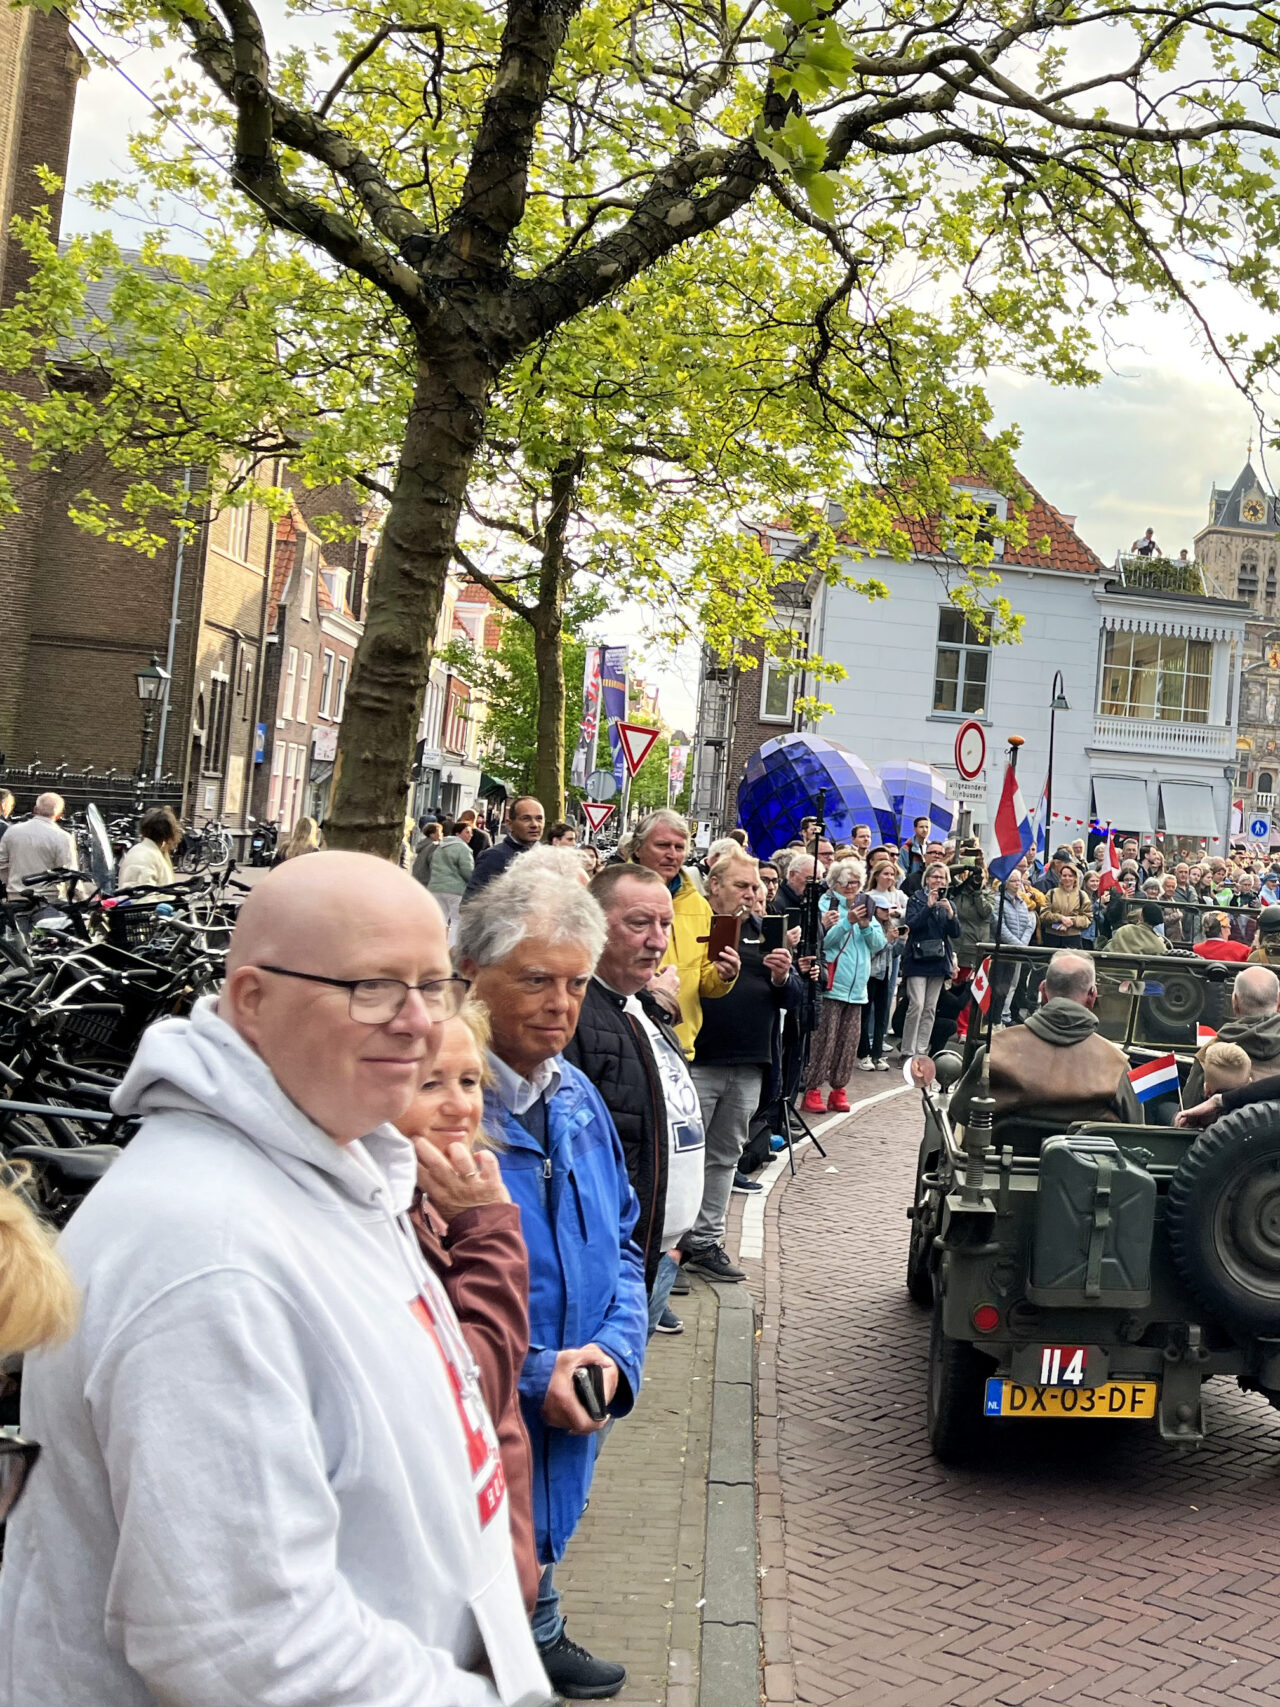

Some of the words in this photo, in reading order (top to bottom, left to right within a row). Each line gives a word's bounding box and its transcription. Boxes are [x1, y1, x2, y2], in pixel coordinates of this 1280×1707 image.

[1040, 1348, 1085, 1386] 114
[987, 1401, 1000, 1410] NL
[1009, 1384, 1147, 1413] DX-03-DF
